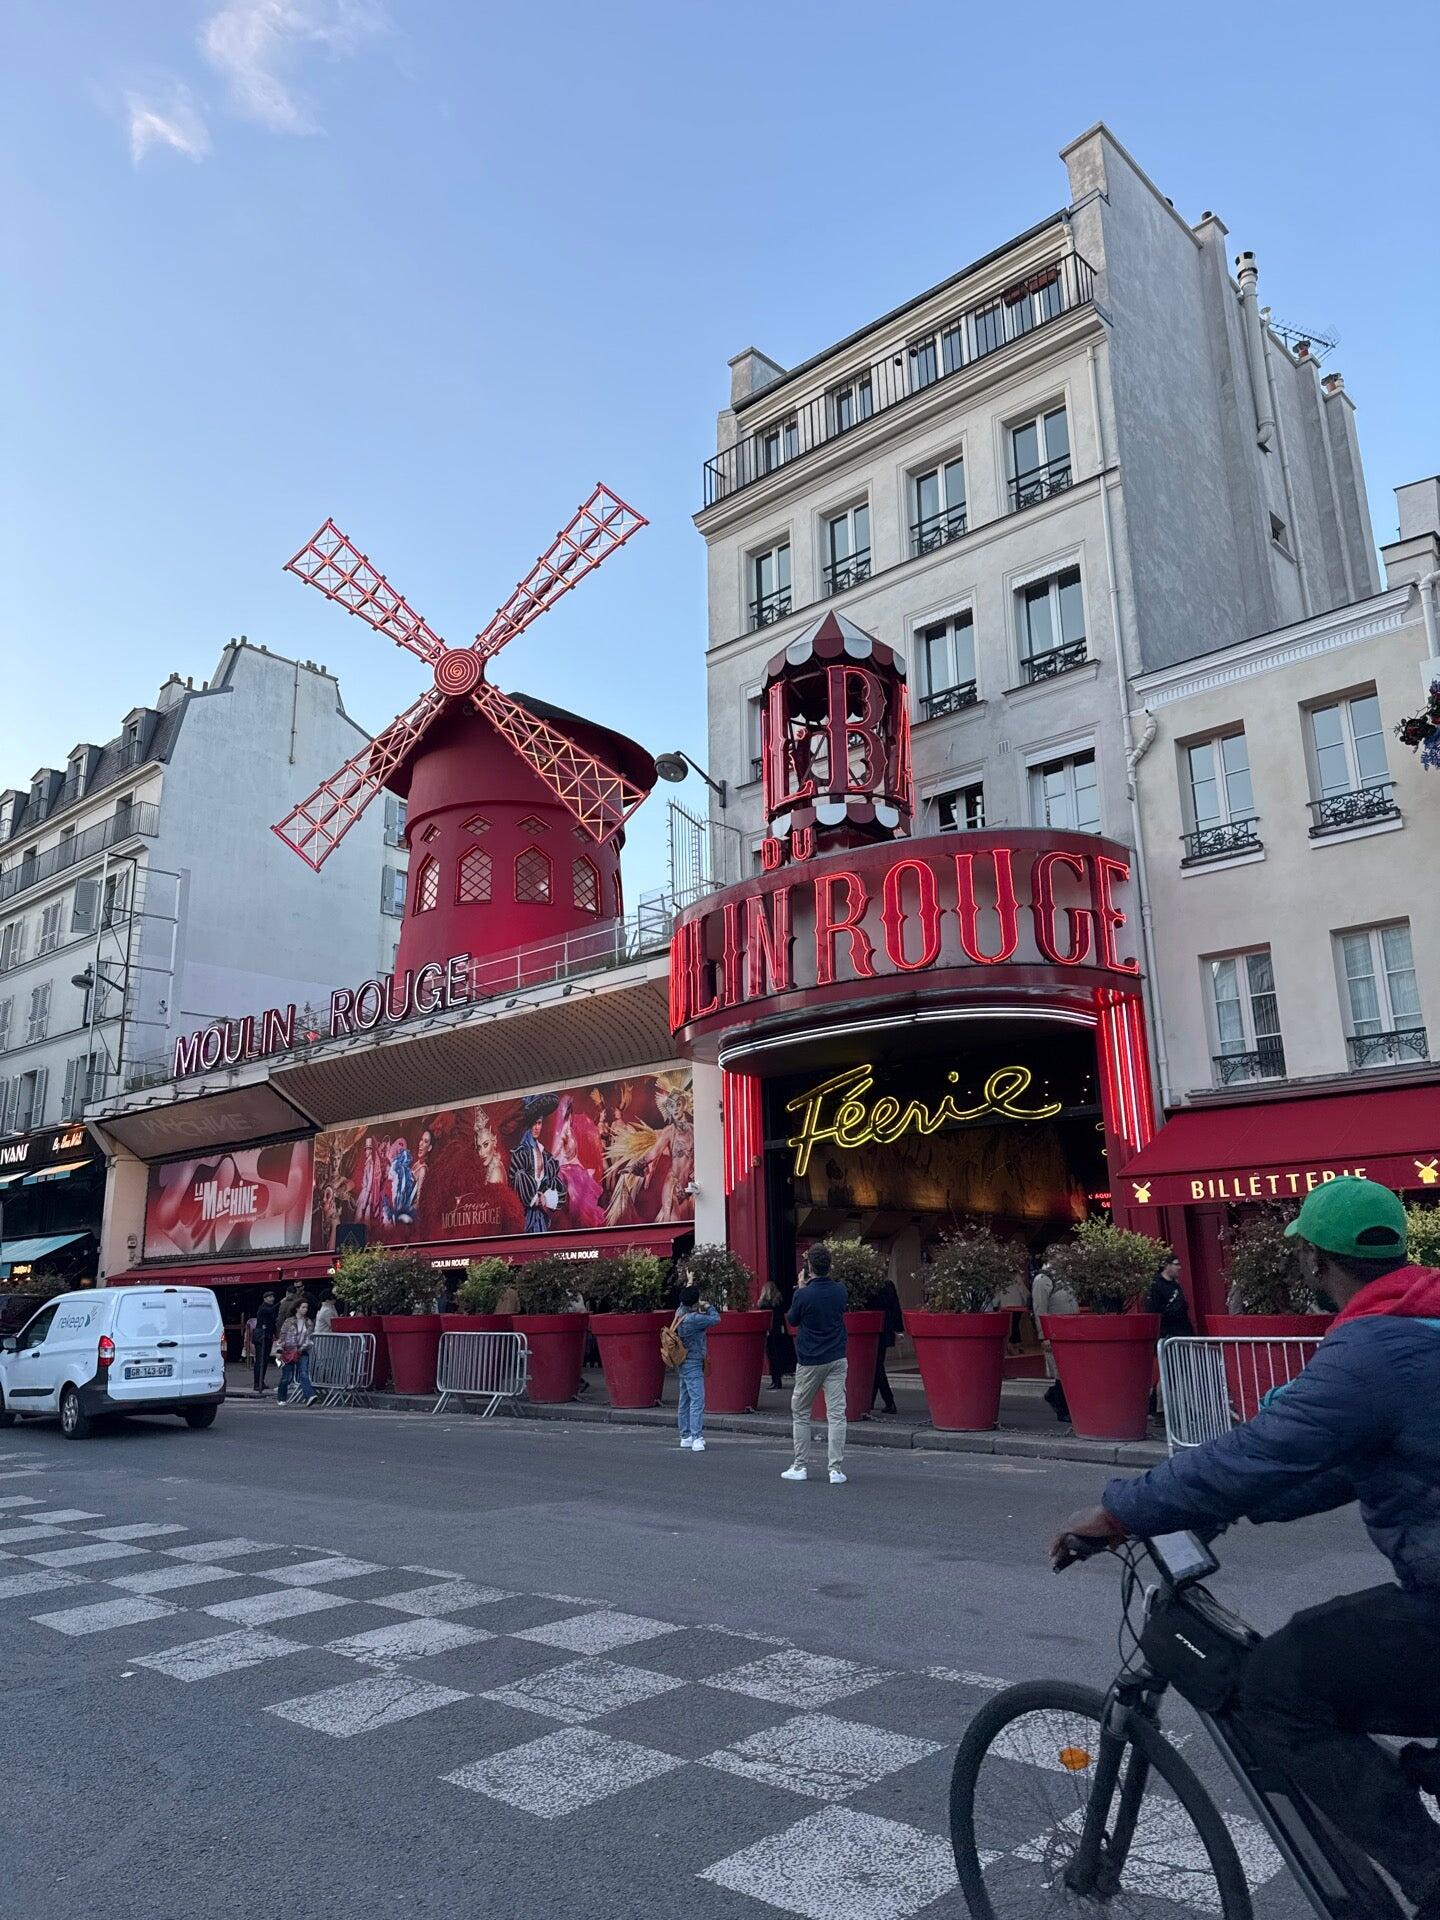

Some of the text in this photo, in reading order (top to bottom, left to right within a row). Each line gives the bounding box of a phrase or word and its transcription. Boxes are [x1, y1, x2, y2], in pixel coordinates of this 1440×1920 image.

[762, 828, 813, 870] DU
[814, 849, 1142, 984] ROUGE
[173, 952, 472, 1077] MOULIN ROUGE
[787, 1064, 1062, 1176] Féerie
[442, 1207, 501, 1229] MOULIN ROUGE
[58, 1314, 84, 1331] rekeep
